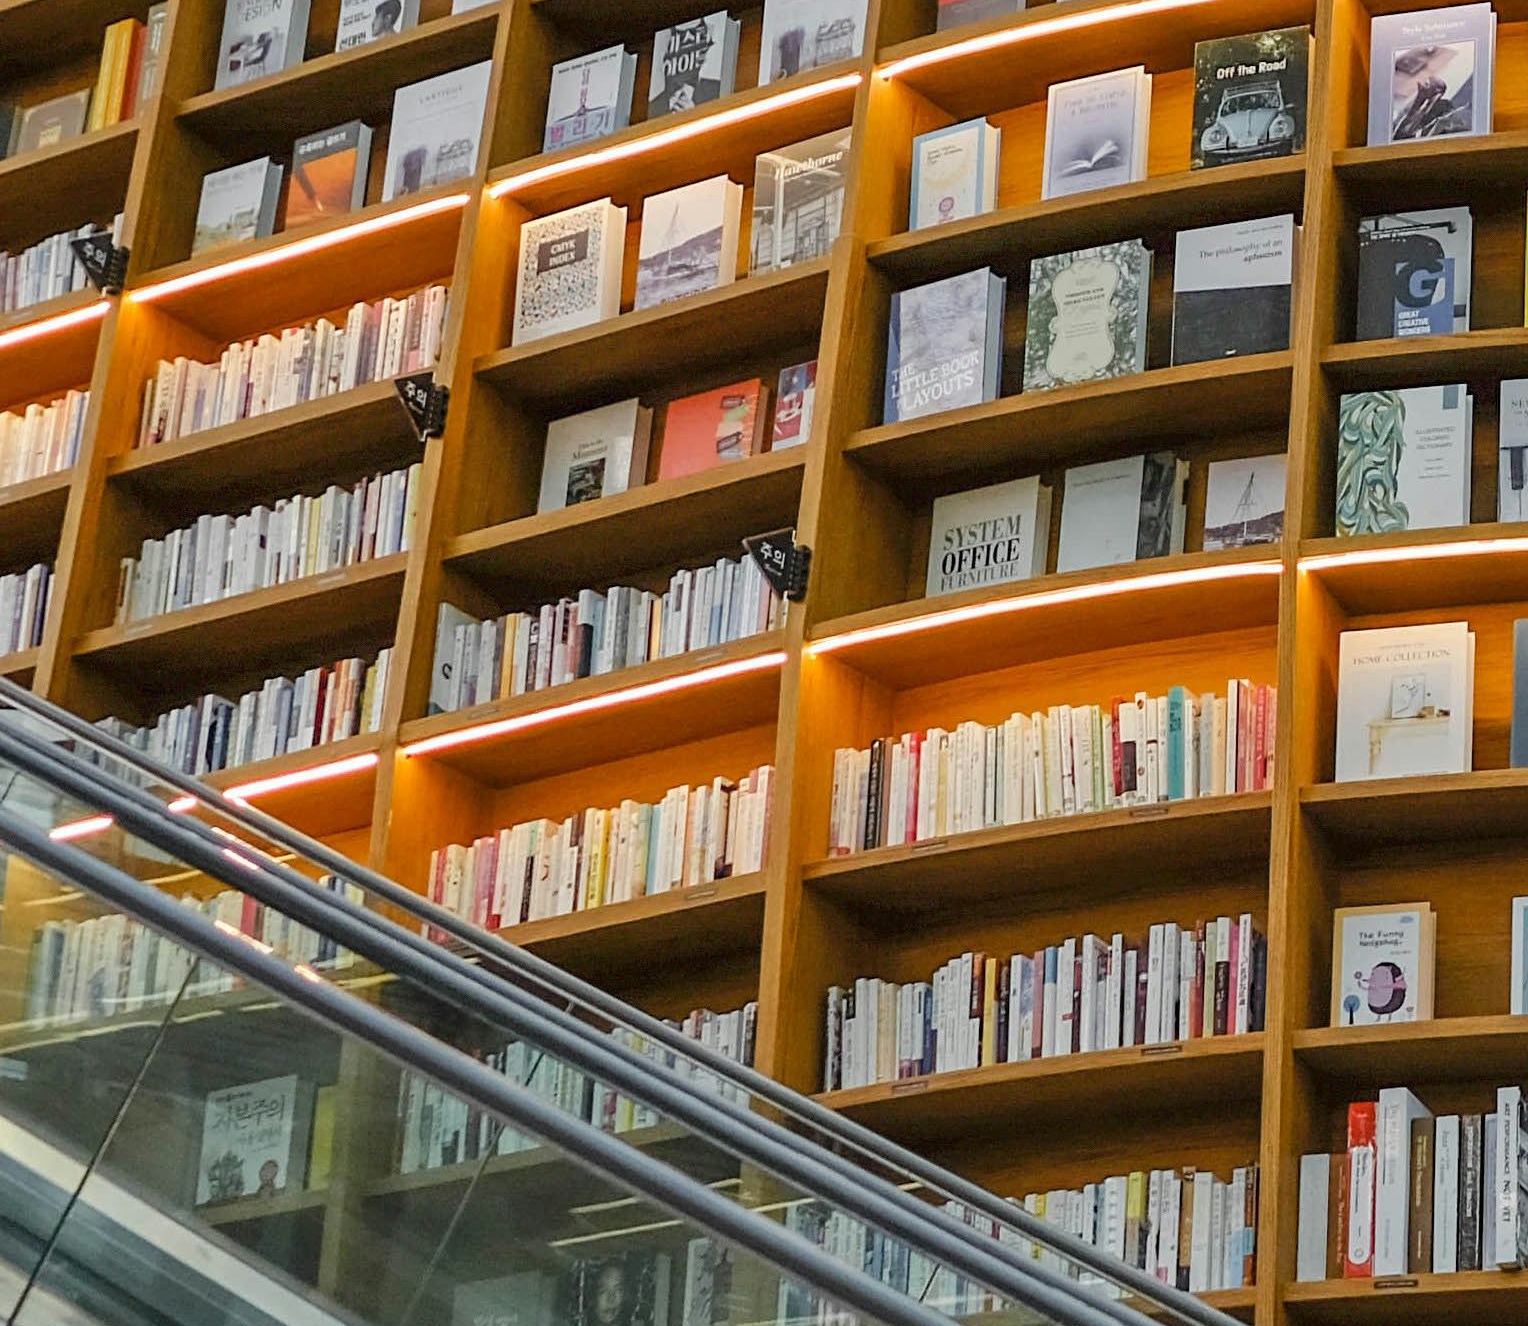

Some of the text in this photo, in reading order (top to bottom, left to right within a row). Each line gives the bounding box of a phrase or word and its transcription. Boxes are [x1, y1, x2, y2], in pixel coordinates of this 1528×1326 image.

[1216, 58, 1289, 80] Off the Road
[774, 150, 844, 181] Hawthorne
[891, 350, 981, 399] LITTLE BOOK
[403, 378, 429, 407] 주의
[942, 514, 1023, 552] SYSTEM
[758, 541, 787, 571] 주의
[941, 537, 1021, 577] OFFICE
[939, 561, 1019, 593] FURNITURE
[1385, 649, 1452, 663] COLLECTION
